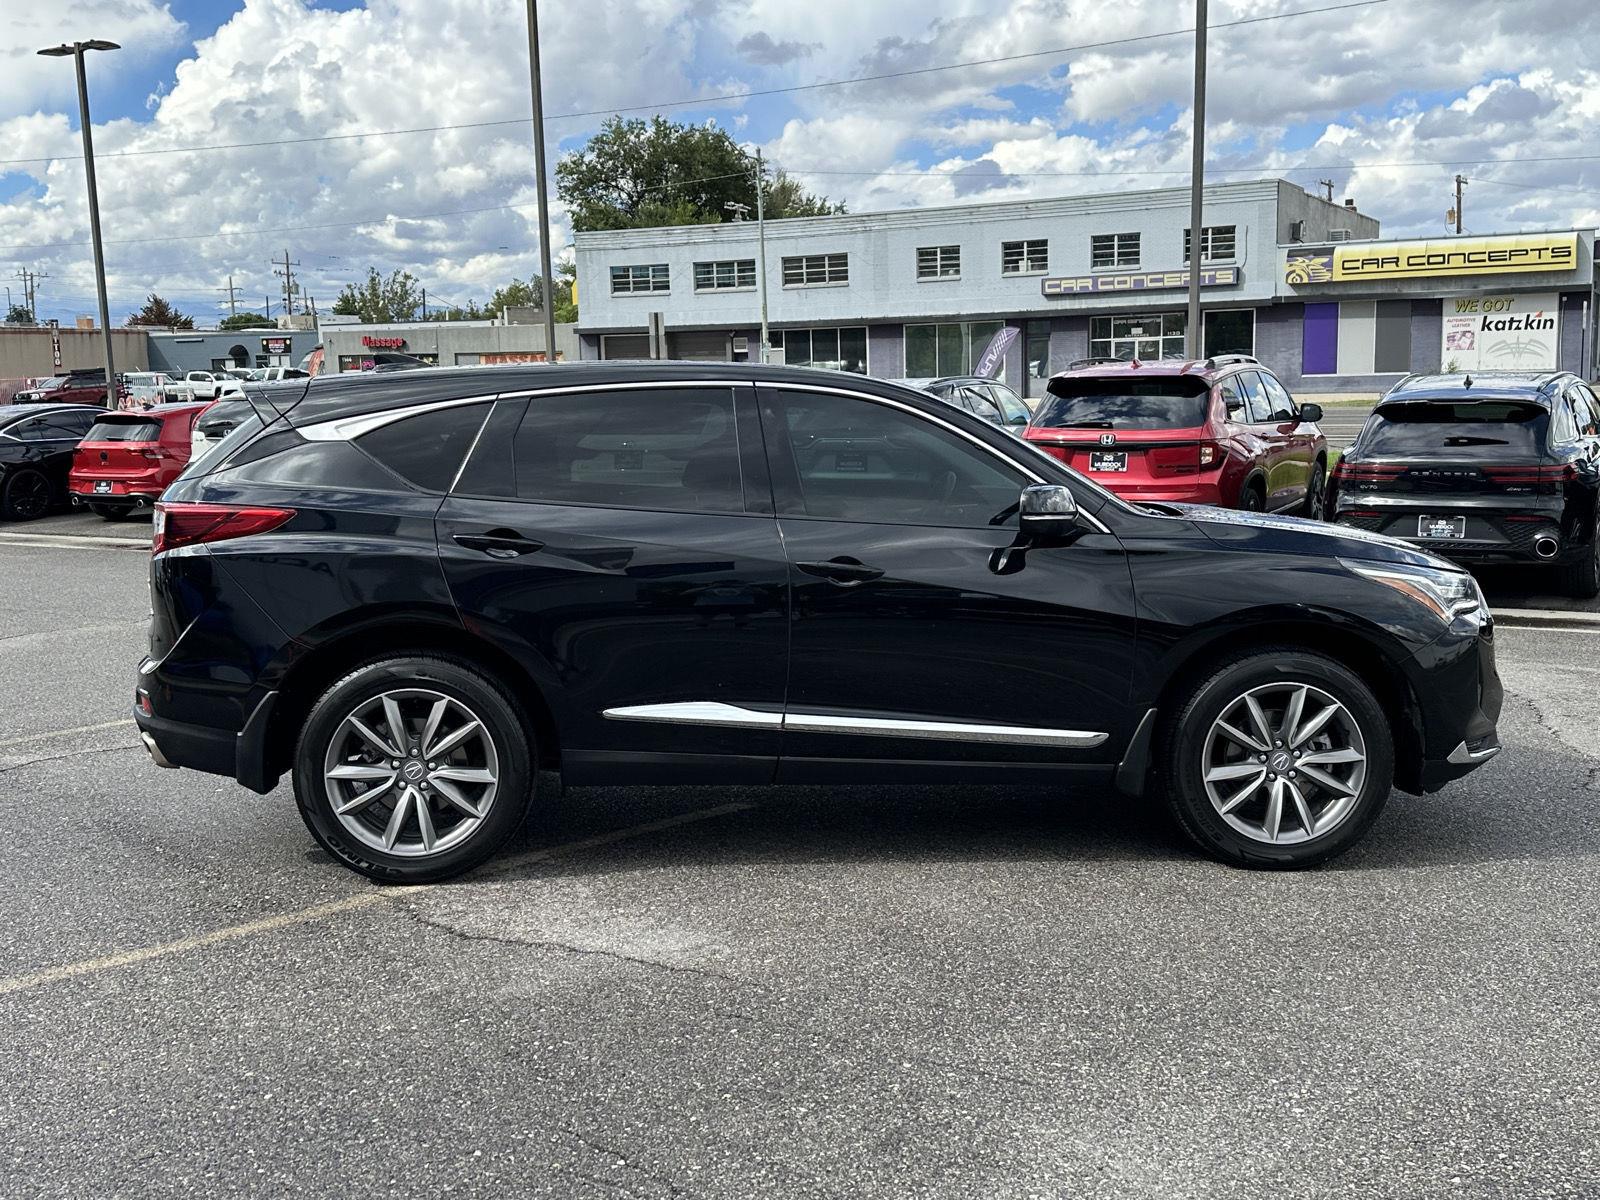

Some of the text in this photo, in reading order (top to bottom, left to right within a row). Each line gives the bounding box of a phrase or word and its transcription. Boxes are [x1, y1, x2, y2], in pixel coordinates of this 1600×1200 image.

[1342, 245, 1572, 271] CAR CONCEPTS
[1044, 278, 1093, 293] CAR
[1455, 298, 1515, 312] WE GOT
[1480, 311, 1555, 332] katzkin
[361, 335, 405, 349] Massage
